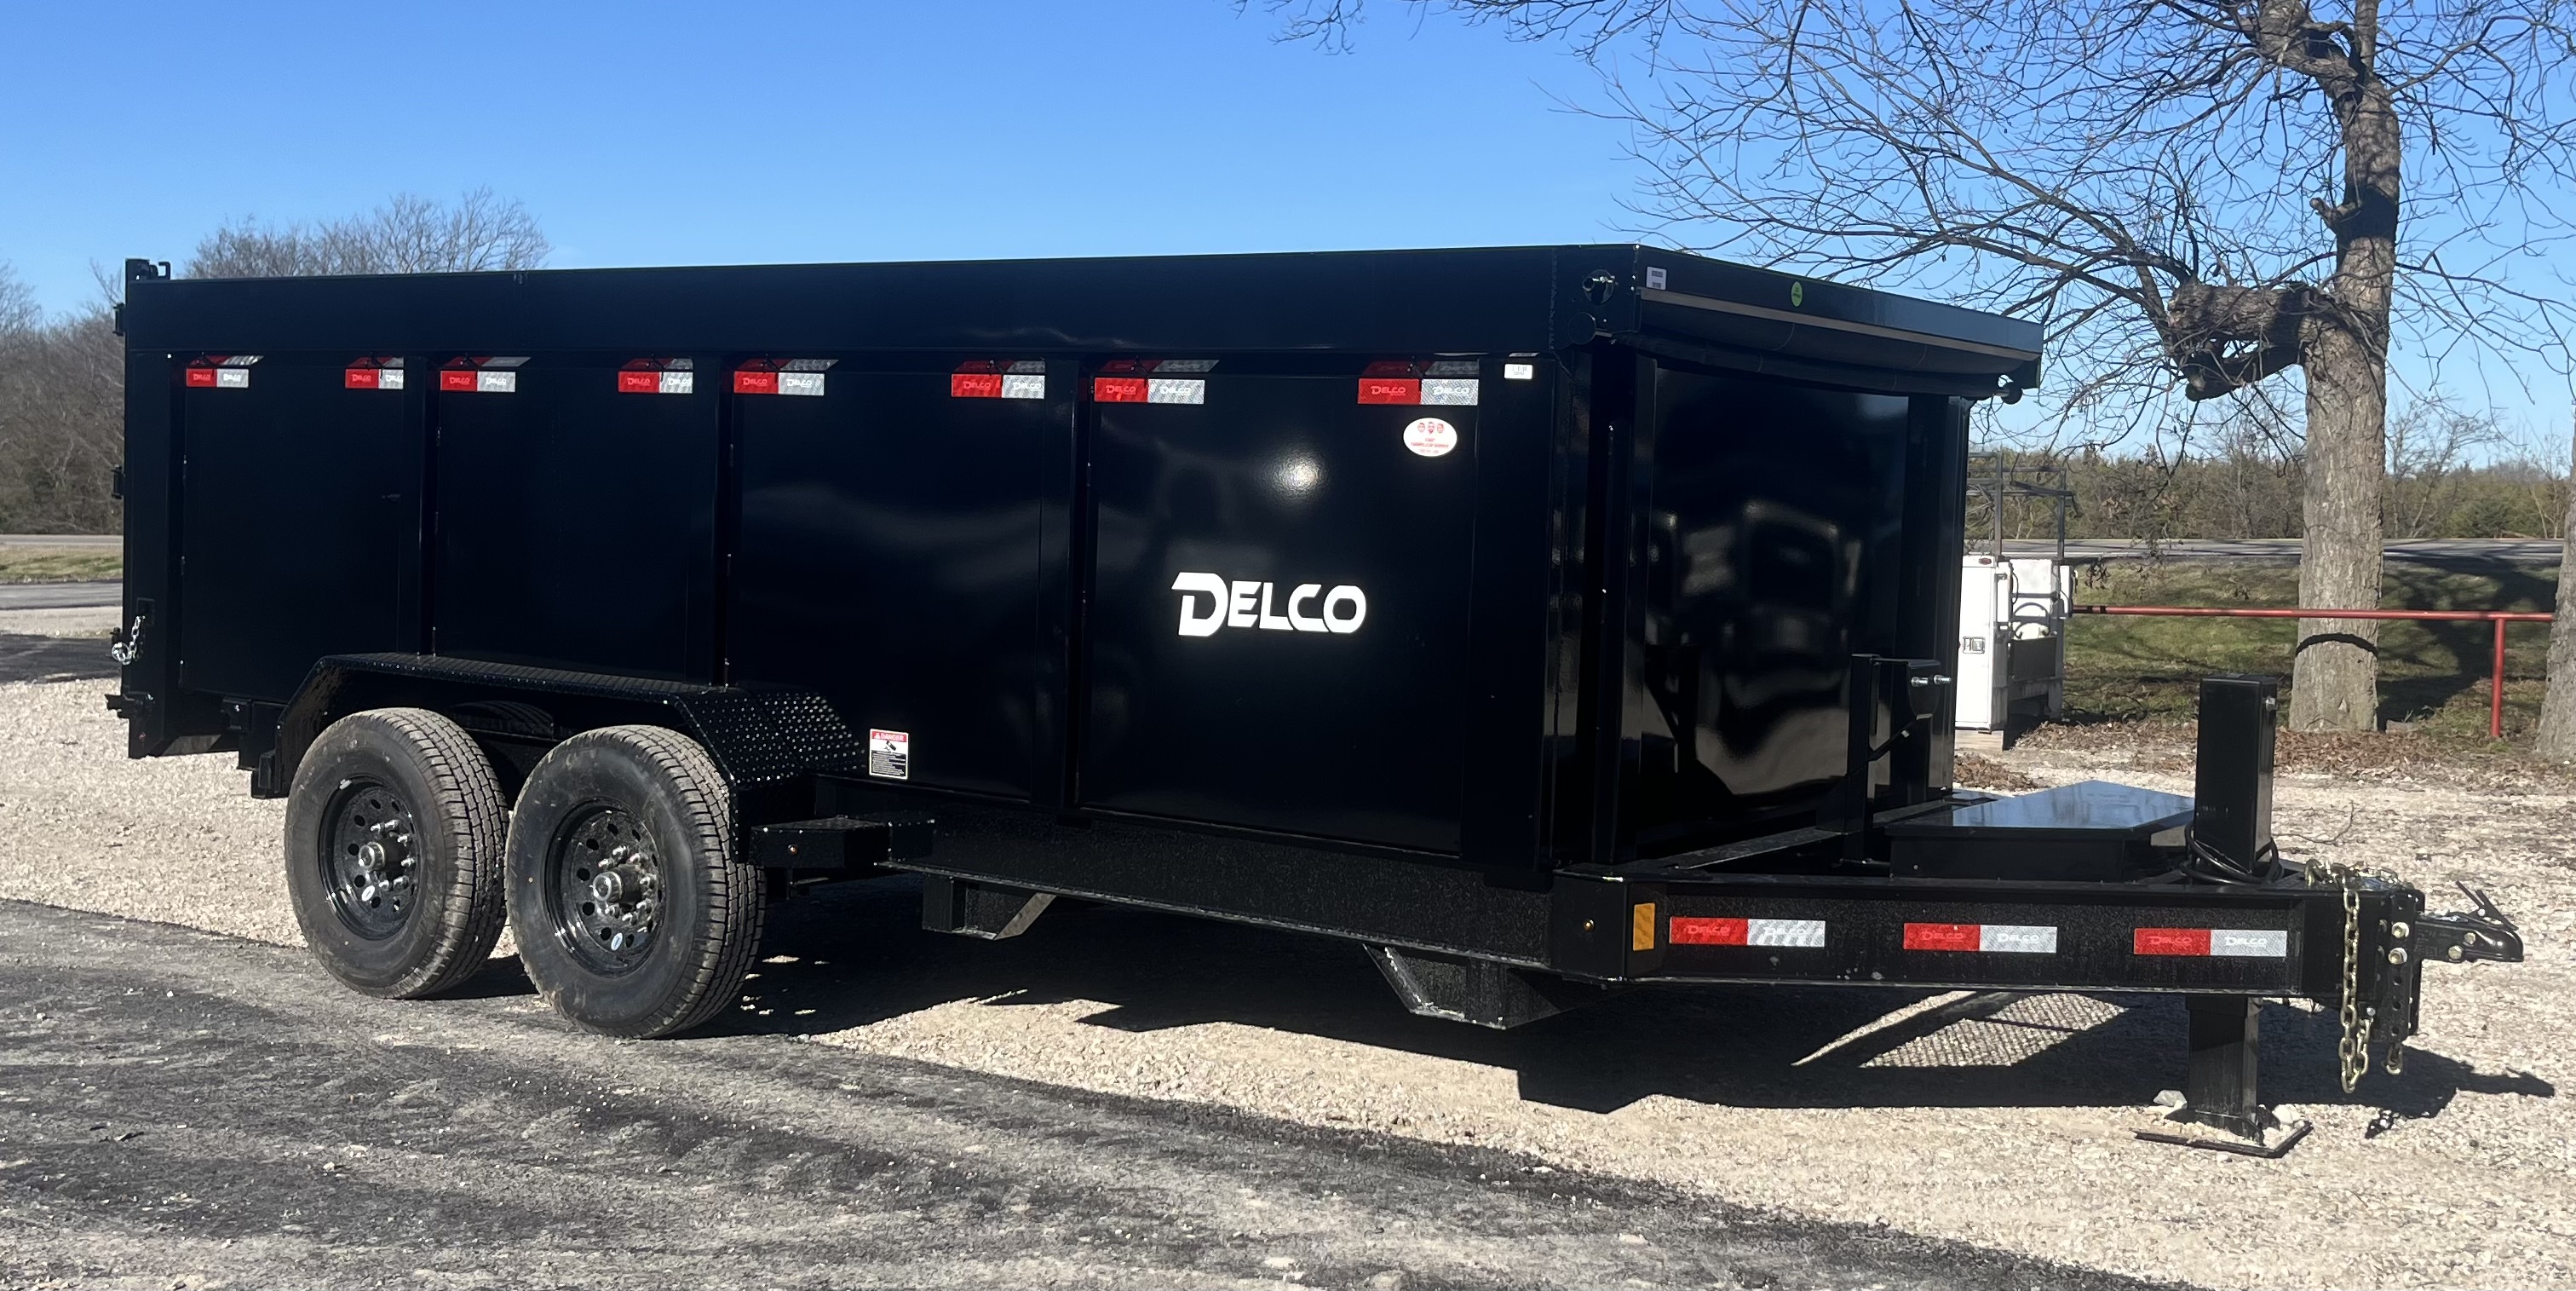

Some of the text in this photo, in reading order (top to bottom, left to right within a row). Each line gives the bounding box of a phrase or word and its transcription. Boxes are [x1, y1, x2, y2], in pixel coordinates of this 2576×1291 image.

[743, 378, 768, 386] DELCO
[786, 378, 812, 387] DELCO
[963, 381, 991, 390] DELCO
[1013, 381, 1041, 390] DELCO
[1106, 385, 1136, 394] DELCO
[1159, 386, 1191, 395] DELCO
[1371, 385, 1406, 395] DELCO
[1433, 386, 1469, 395] DELCO
[1171, 572, 1366, 637] DELCO
[1686, 925, 1730, 936] DELCO
[1920, 931, 1964, 941] DELCO
[1997, 933, 2039, 942] DELCO
[2147, 937, 2193, 945] DELCO
[2225, 937, 2268, 946] DELCO
